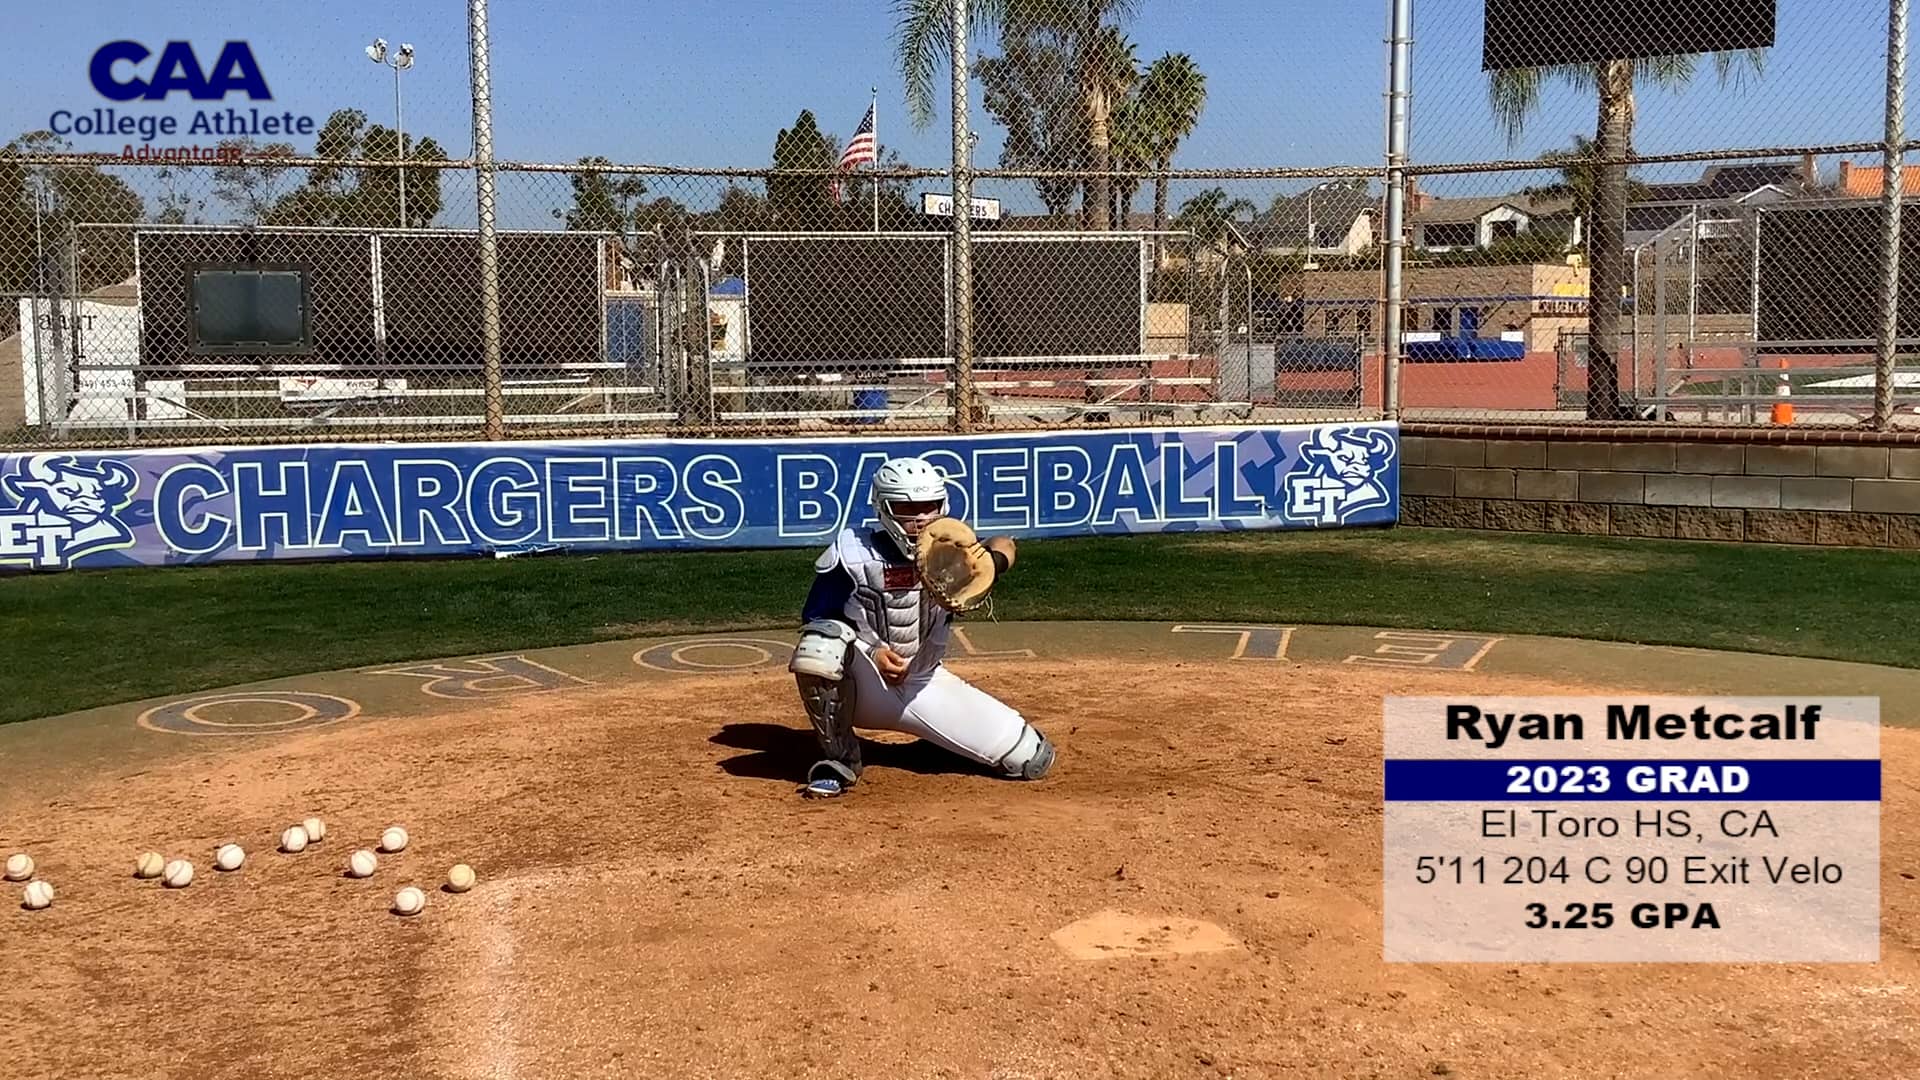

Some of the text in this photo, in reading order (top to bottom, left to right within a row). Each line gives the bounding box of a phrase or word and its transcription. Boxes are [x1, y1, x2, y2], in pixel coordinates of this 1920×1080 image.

[938, 201, 987, 217] CHERS
[153, 454, 746, 554] CHARGERS
[1292, 479, 1346, 523] ET
[0, 514, 72, 566] ET
